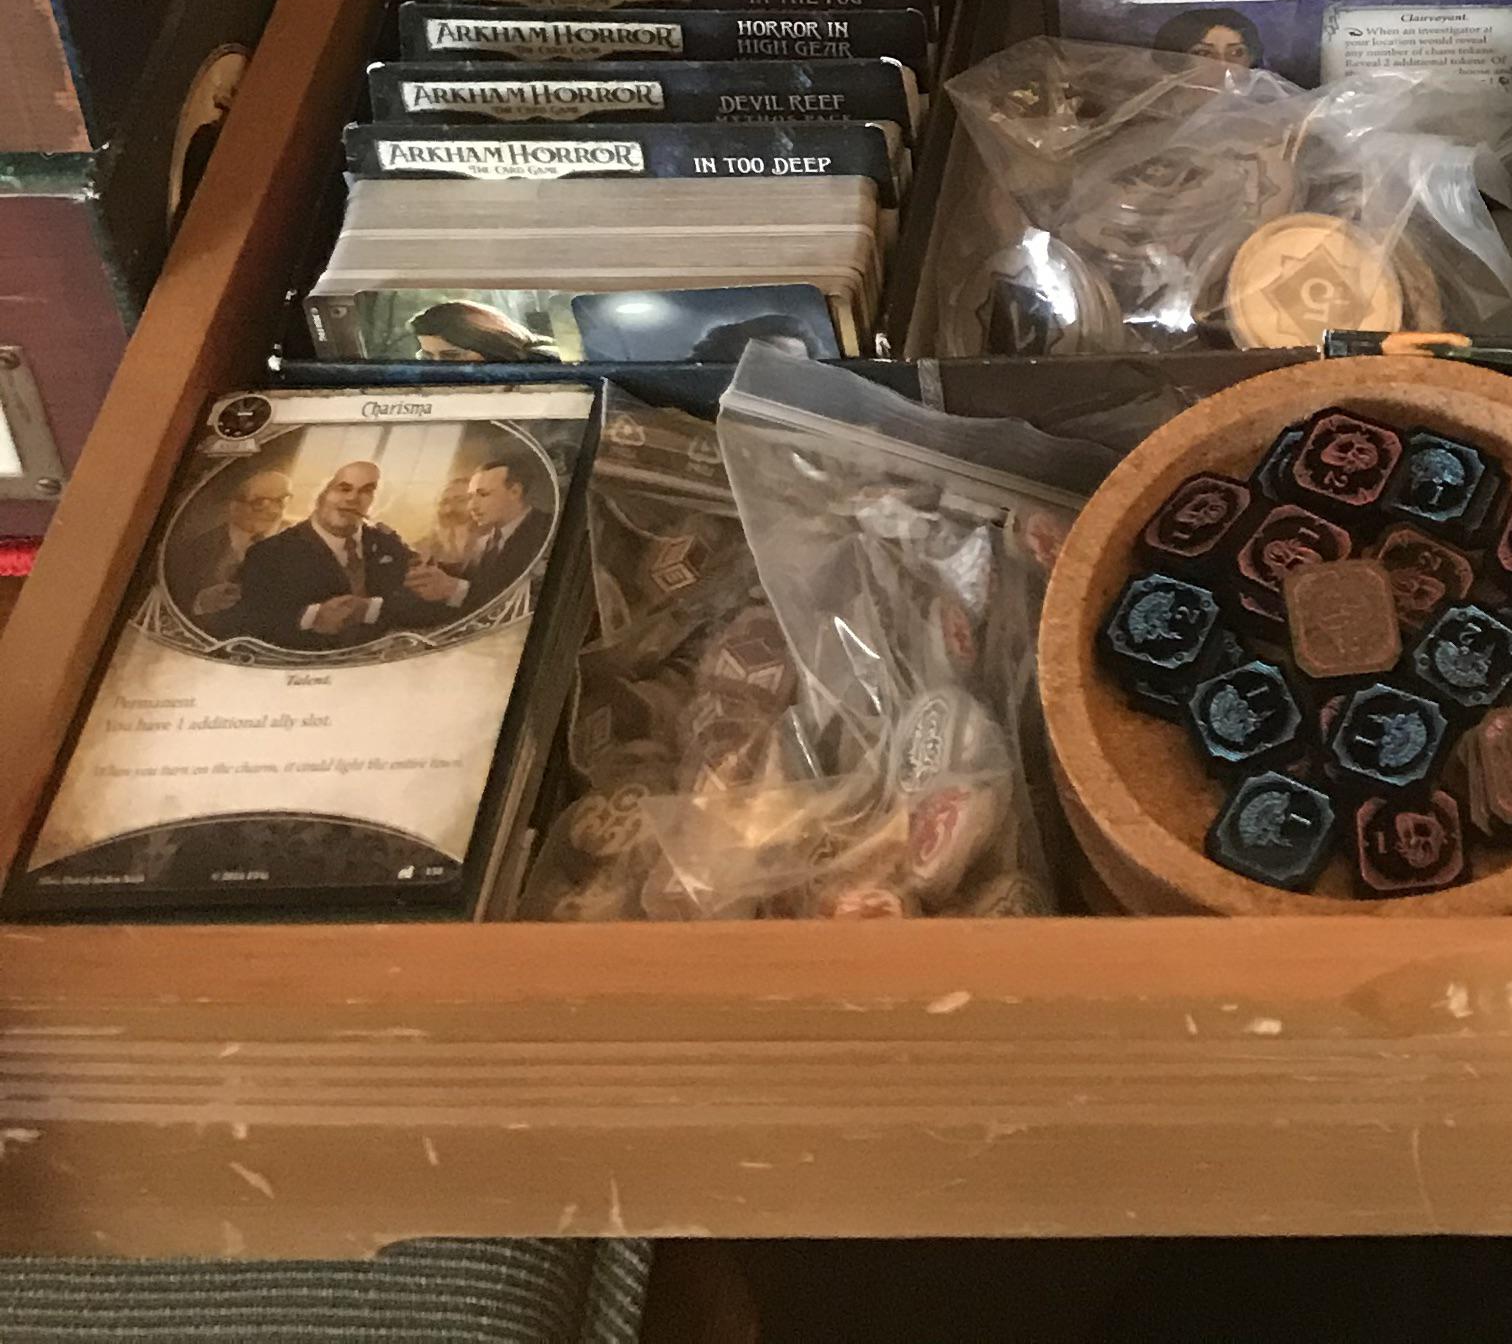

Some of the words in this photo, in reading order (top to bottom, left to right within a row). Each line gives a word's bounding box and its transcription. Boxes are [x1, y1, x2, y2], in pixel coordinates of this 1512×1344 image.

[437, 22, 549, 44] ARKHAM
[552, 24, 680, 49] HORROR
[737, 20, 822, 40] HORROR
[827, 22, 849, 38] IN
[737, 38, 788, 55] HIGH
[794, 41, 853, 59] GEAR
[414, 85, 525, 106] ARKHAM
[529, 84, 659, 106] HORROR
[718, 95, 785, 113] DEVIL
[789, 95, 846, 112] REEF
[389, 144, 505, 166] ARKHAM
[508, 144, 640, 167] HORROR
[693, 157, 717, 173] IN
[722, 157, 765, 173] TOO
[771, 157, 832, 175] DEEP
[362, 401, 432, 417] Charisma
